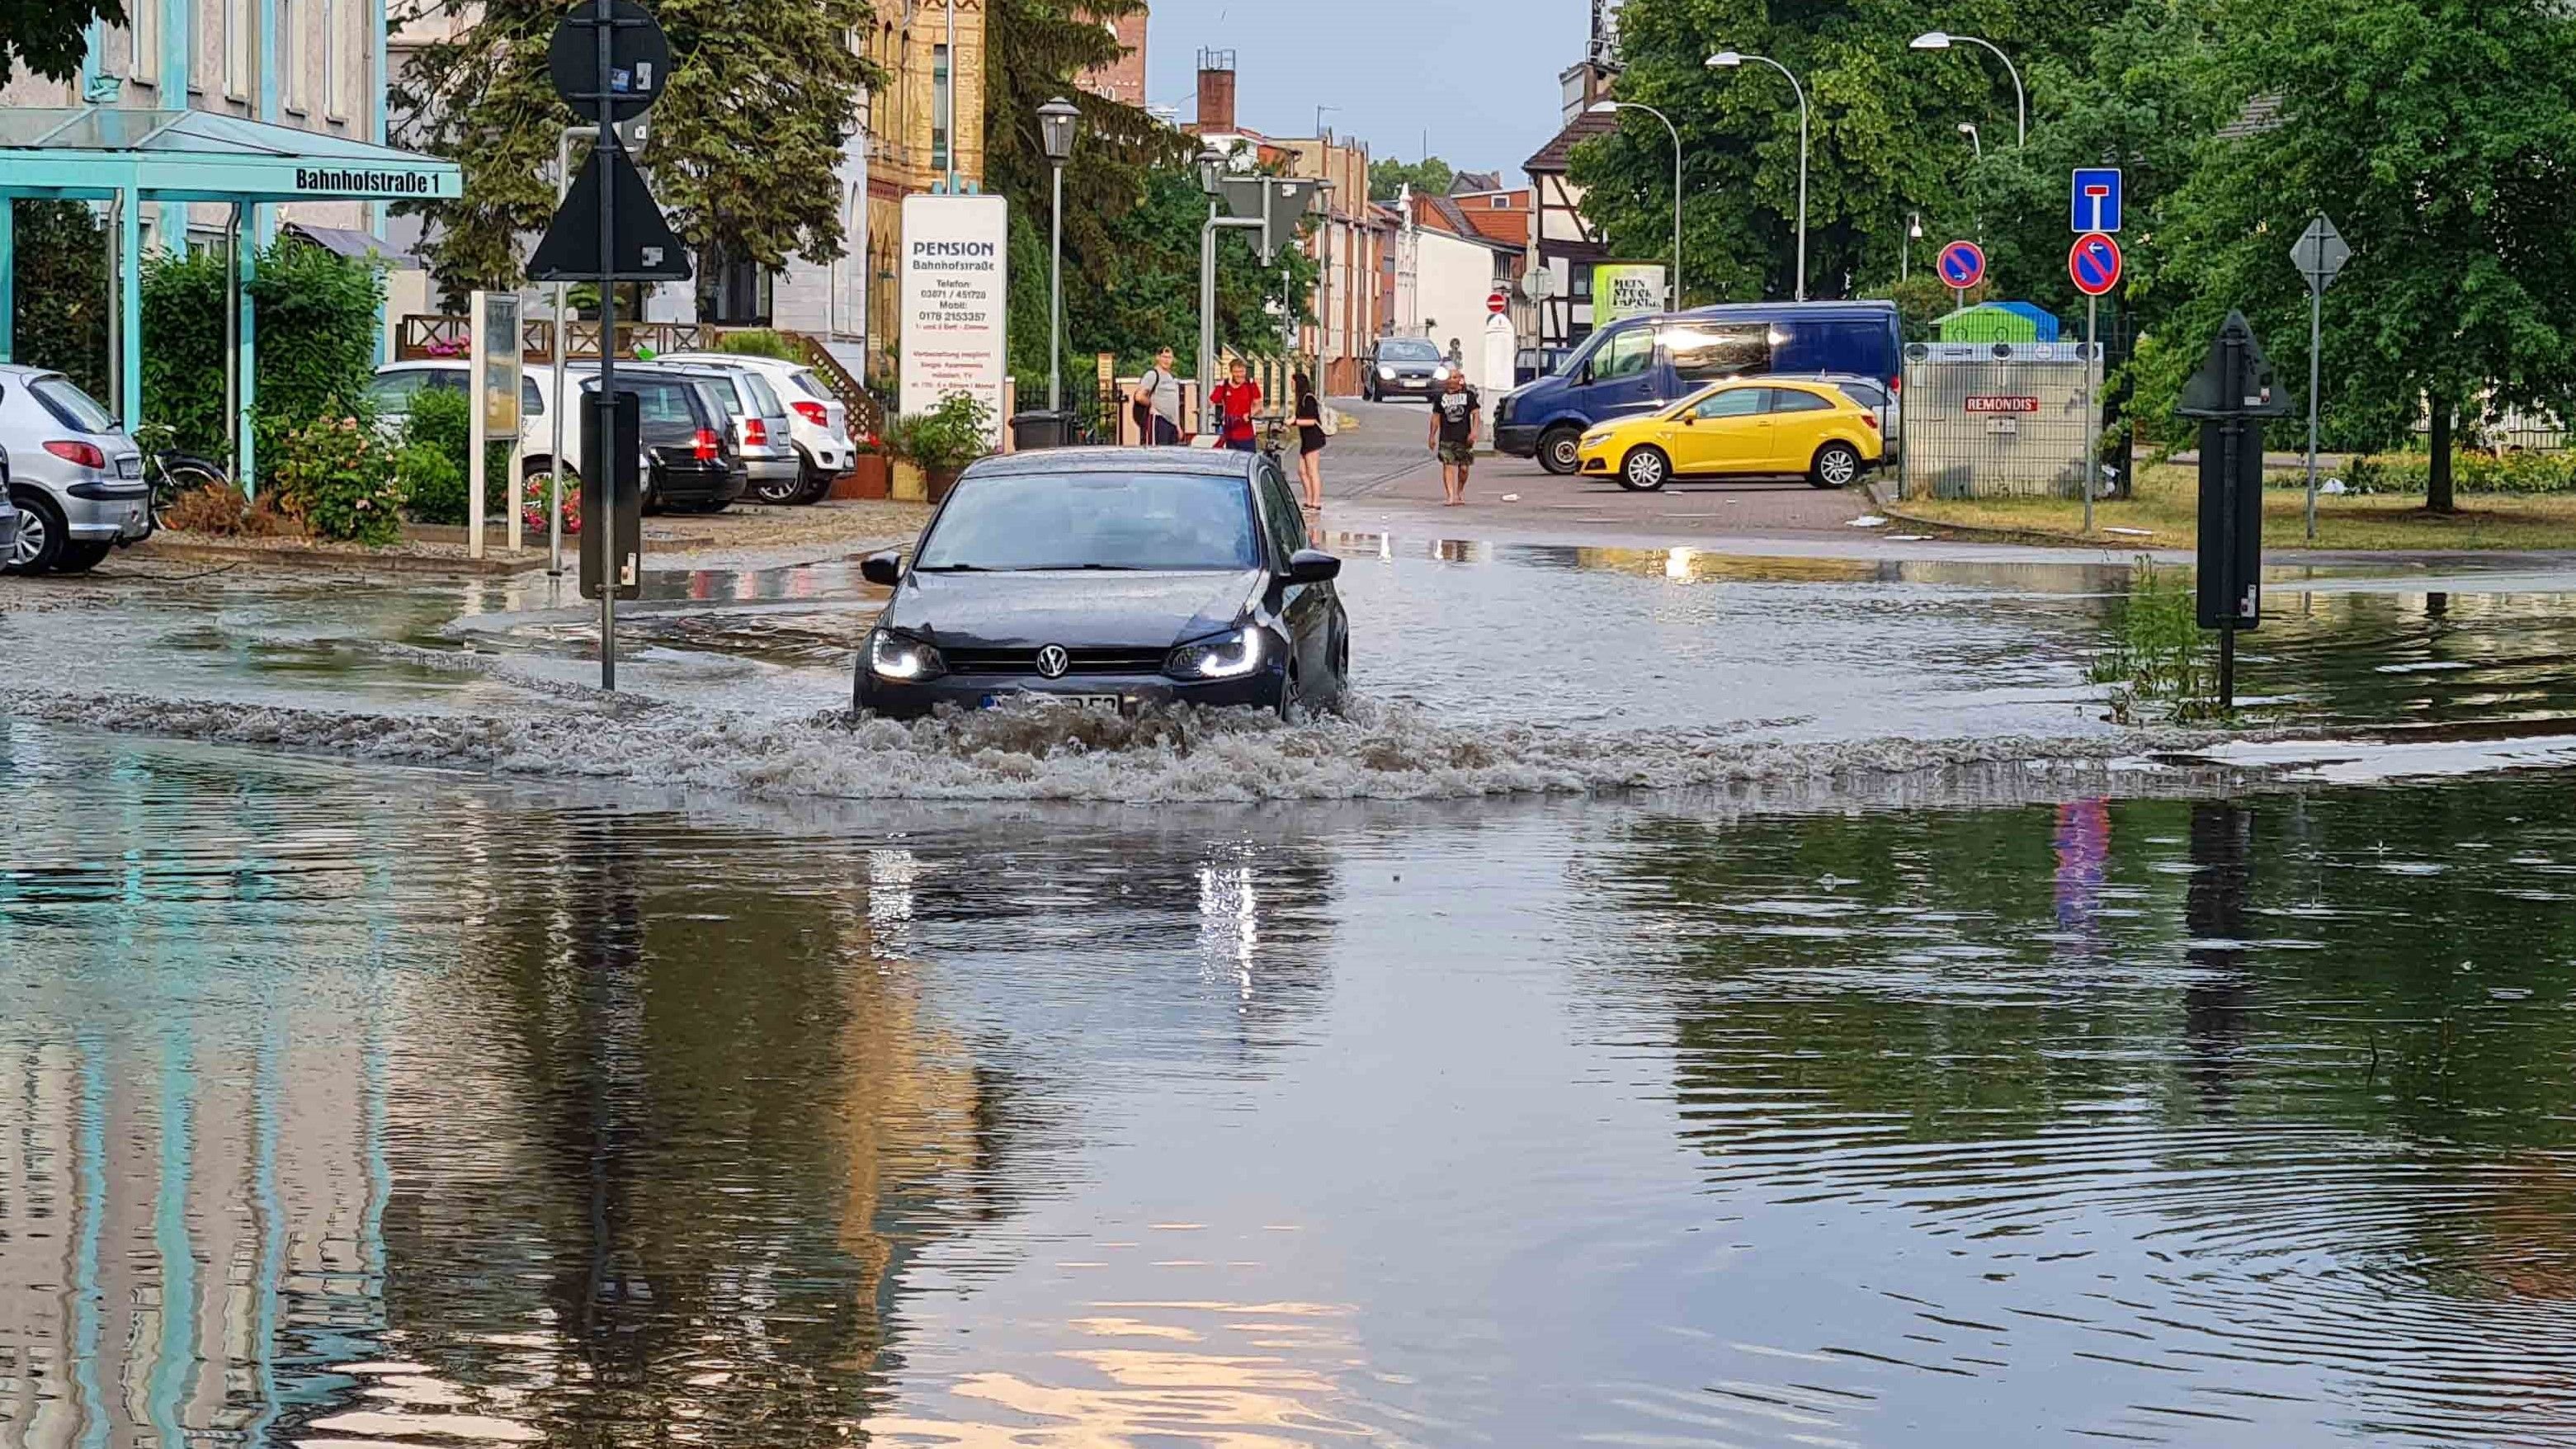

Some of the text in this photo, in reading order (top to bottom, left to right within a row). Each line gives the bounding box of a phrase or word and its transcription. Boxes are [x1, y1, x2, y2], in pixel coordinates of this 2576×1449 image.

[296, 169, 439, 193] Bahnhofstraße 1
[913, 242, 994, 256] PENSION
[913, 260, 994, 271] Bahnhofstraße
[1967, 399, 2032, 410] REMONDIS
